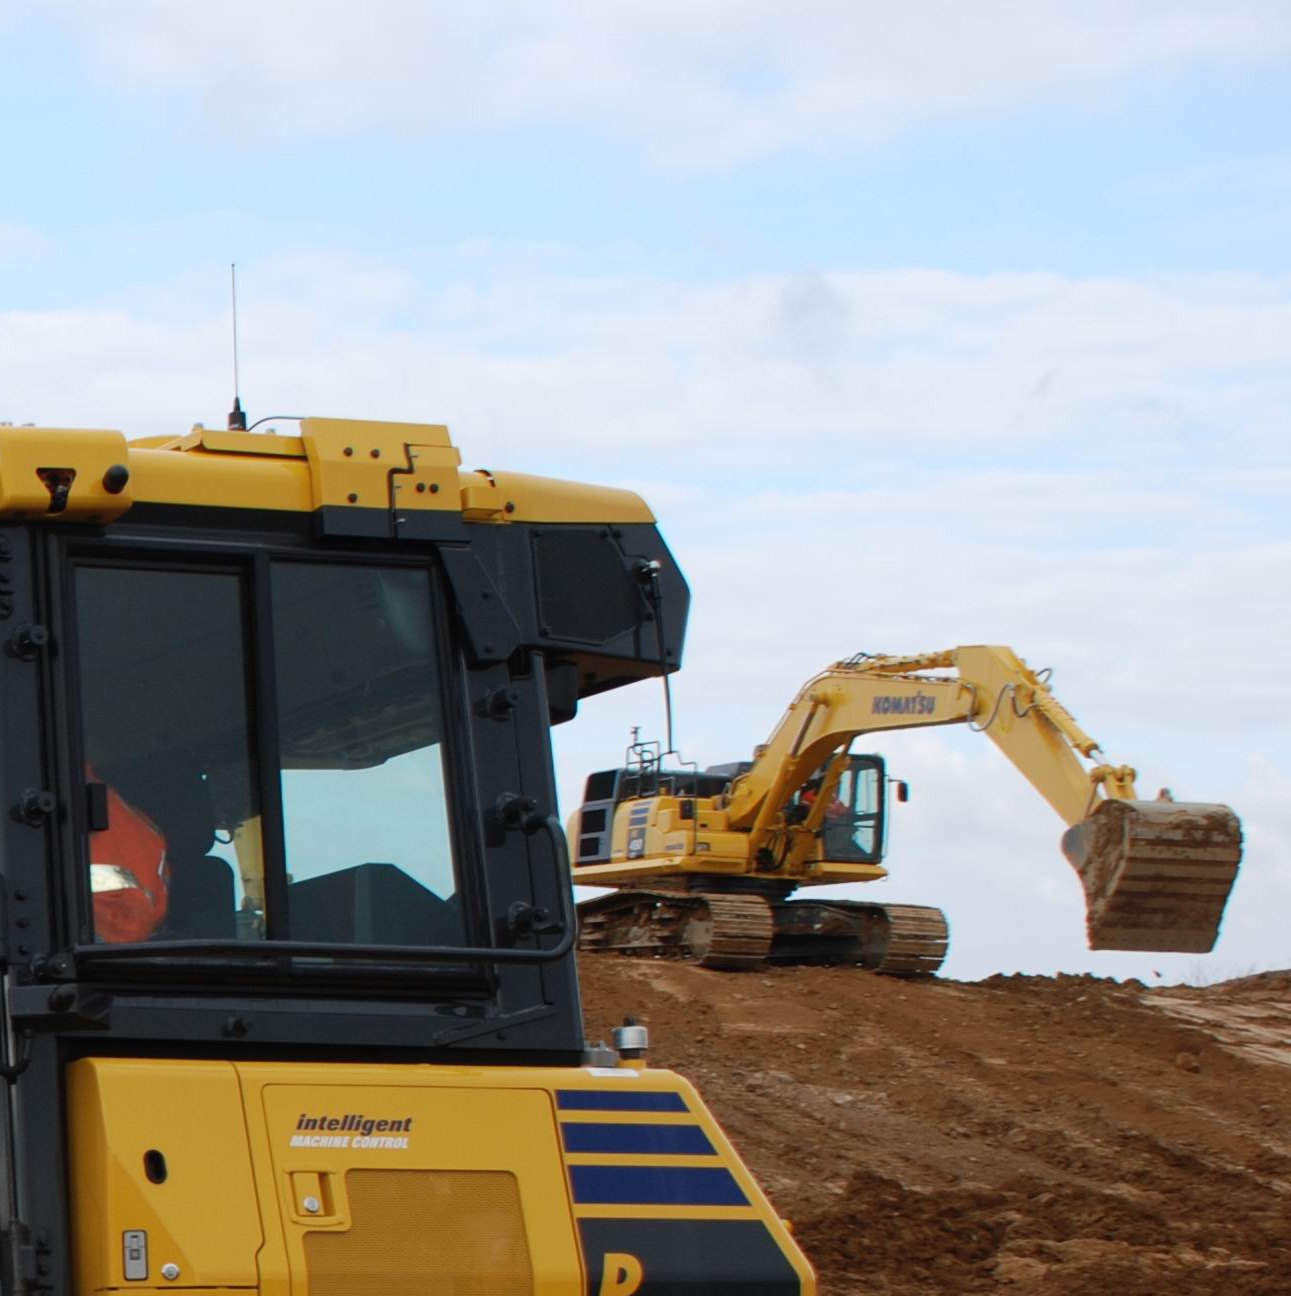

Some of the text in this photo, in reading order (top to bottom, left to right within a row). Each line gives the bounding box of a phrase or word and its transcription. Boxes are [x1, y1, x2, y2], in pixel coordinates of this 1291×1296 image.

[872, 690, 936, 715] KOMATSU
[296, 1113, 412, 1136] intelligent
[289, 1135, 409, 1149] MACHINE CONTROL
